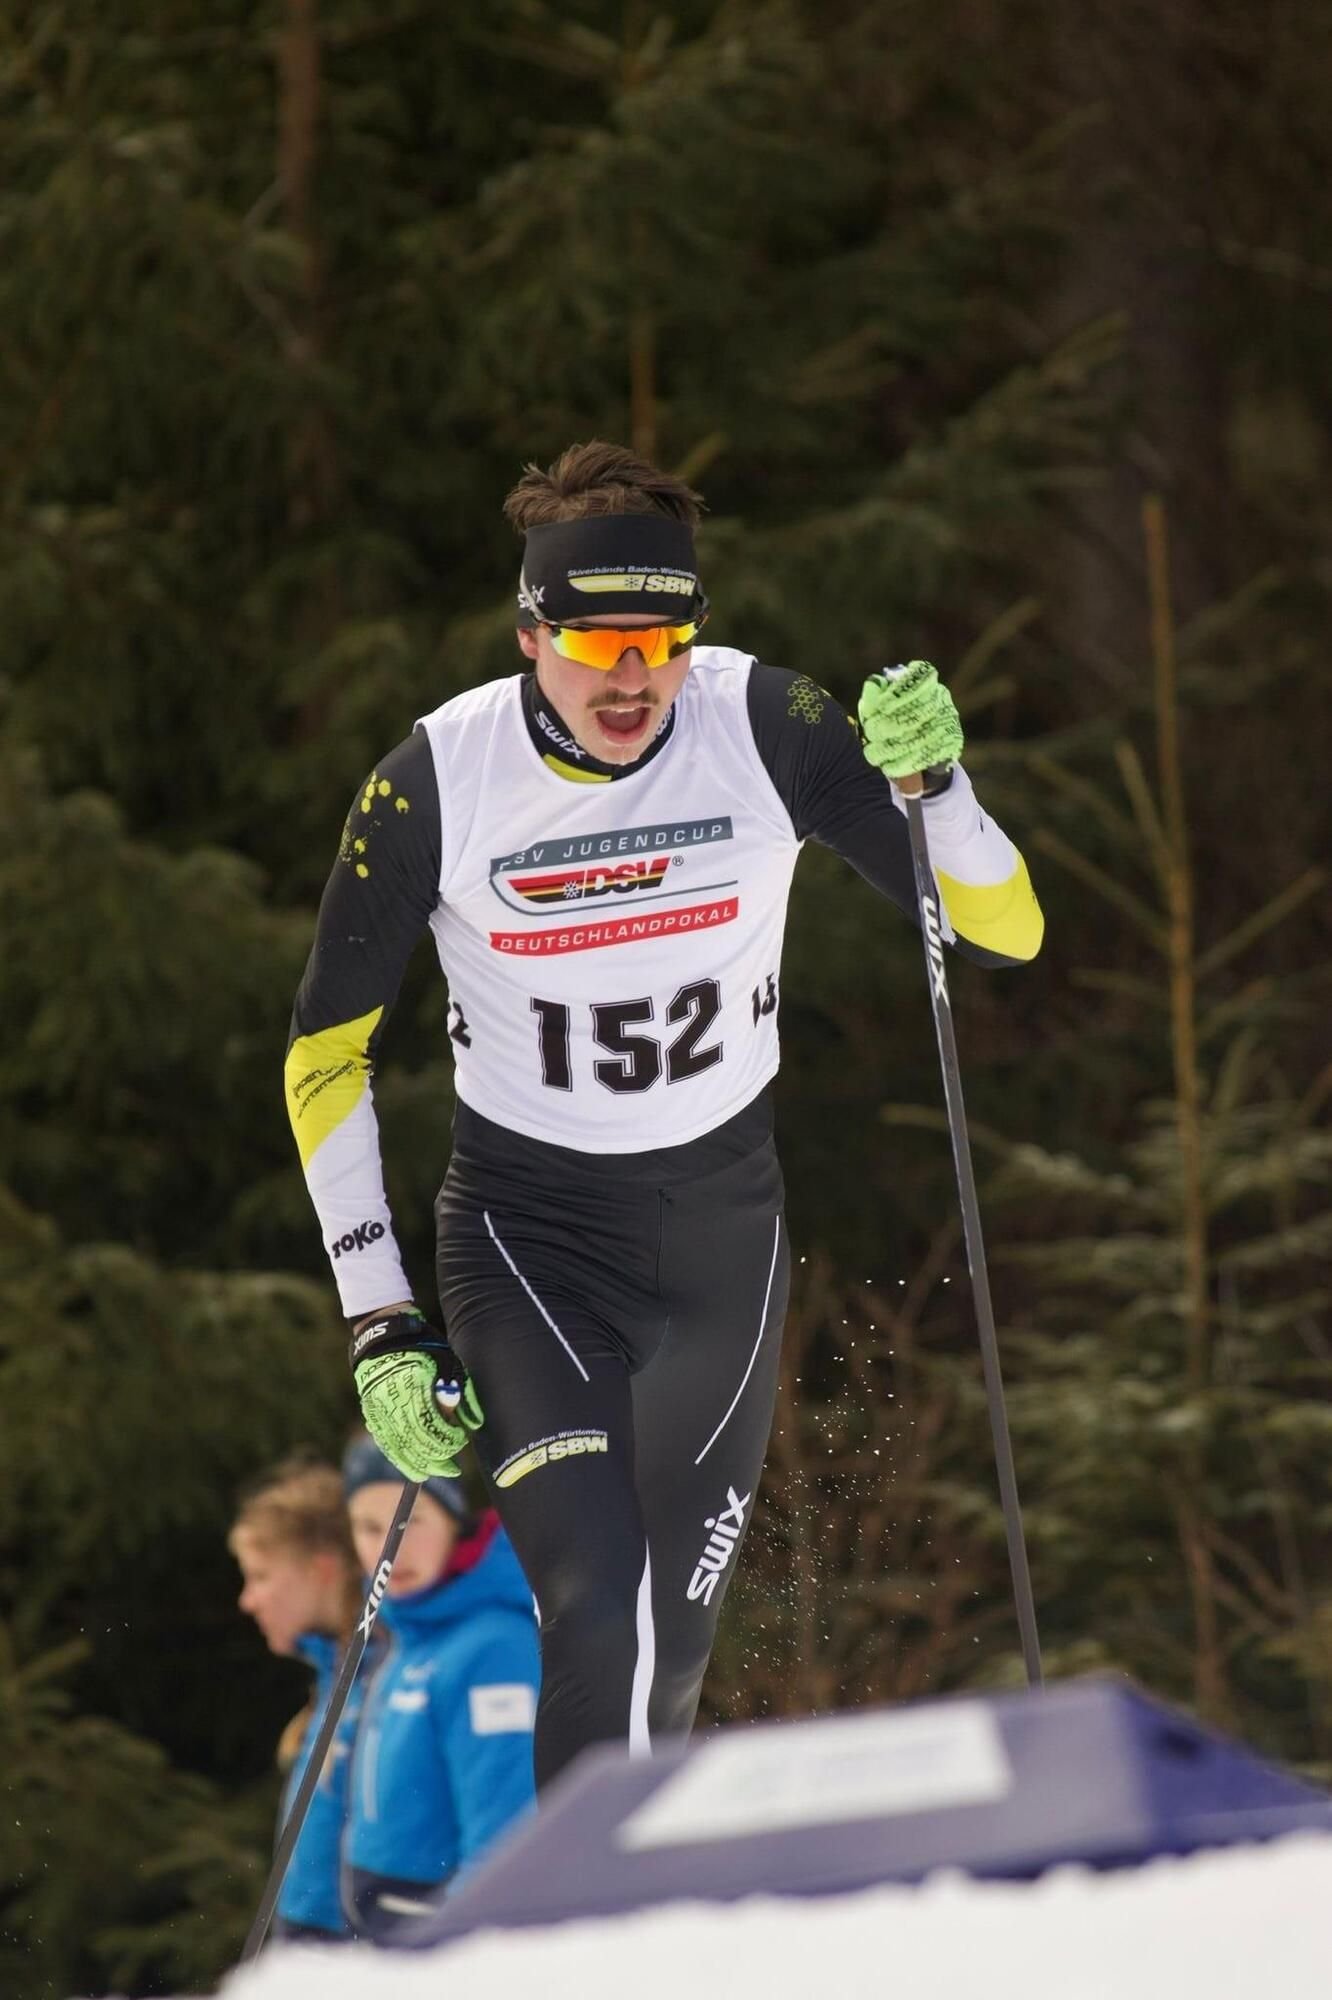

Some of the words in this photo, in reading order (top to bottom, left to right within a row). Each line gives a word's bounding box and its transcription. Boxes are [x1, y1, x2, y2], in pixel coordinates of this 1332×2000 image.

[644, 574, 696, 597] SBW
[563, 824, 724, 858] JUGENDCUP
[585, 857, 671, 898] DSV
[500, 906, 733, 951] DEUTSCHLANDPOKAL
[530, 978, 724, 1095] 152
[548, 1437, 608, 1461] SBW
